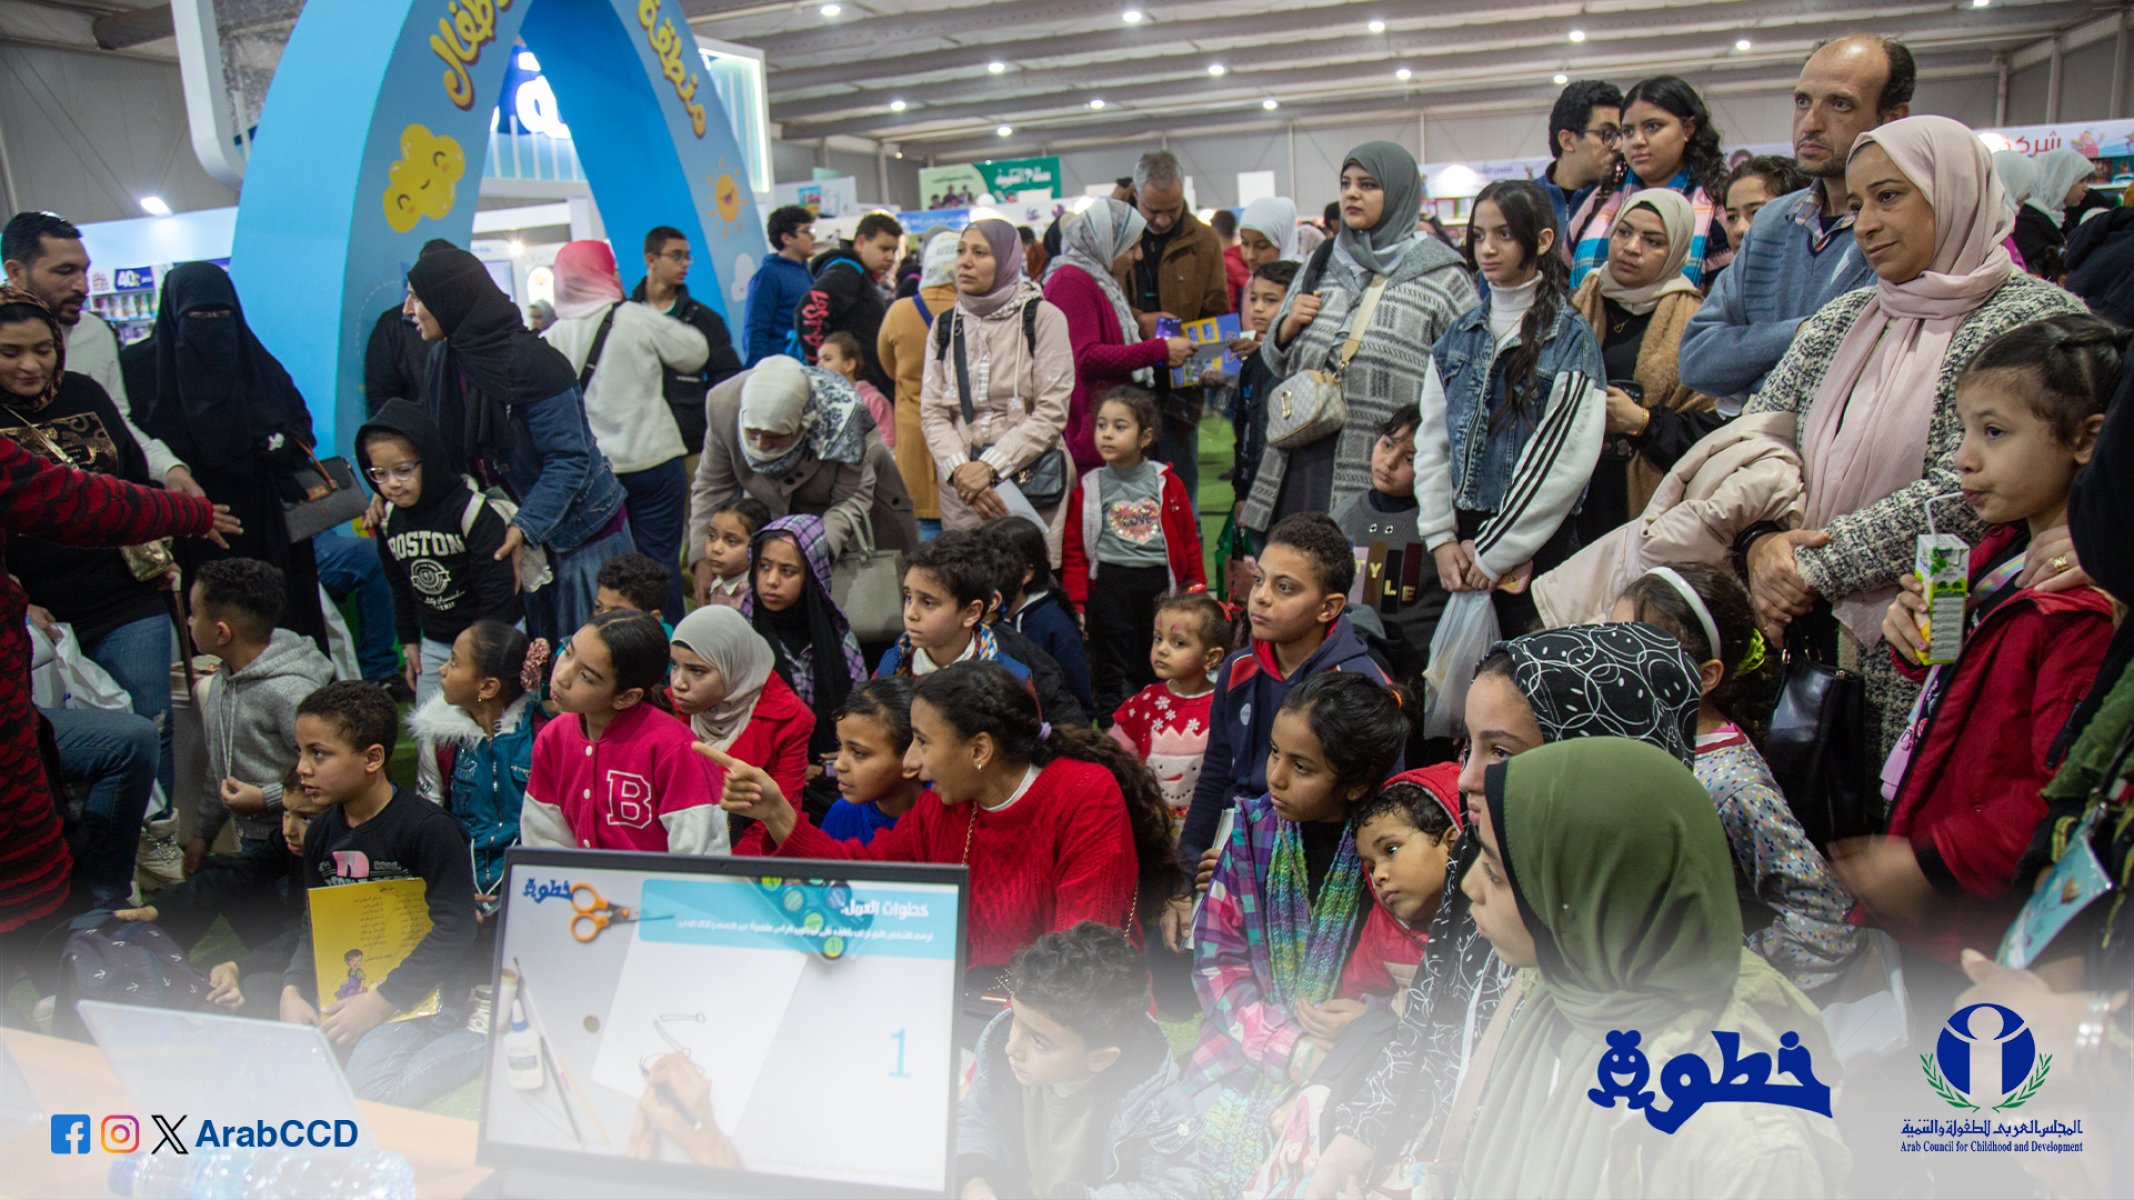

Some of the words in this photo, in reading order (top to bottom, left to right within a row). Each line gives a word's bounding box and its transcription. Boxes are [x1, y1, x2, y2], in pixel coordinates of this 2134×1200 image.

[429, 0, 511, 112] طفال
[638, 0, 707, 139] منطقة
[387, 530, 466, 561] BOSTON
[1354, 559, 1416, 602] TYLE
[606, 769, 652, 830] B
[887, 1026, 912, 1079] 1
